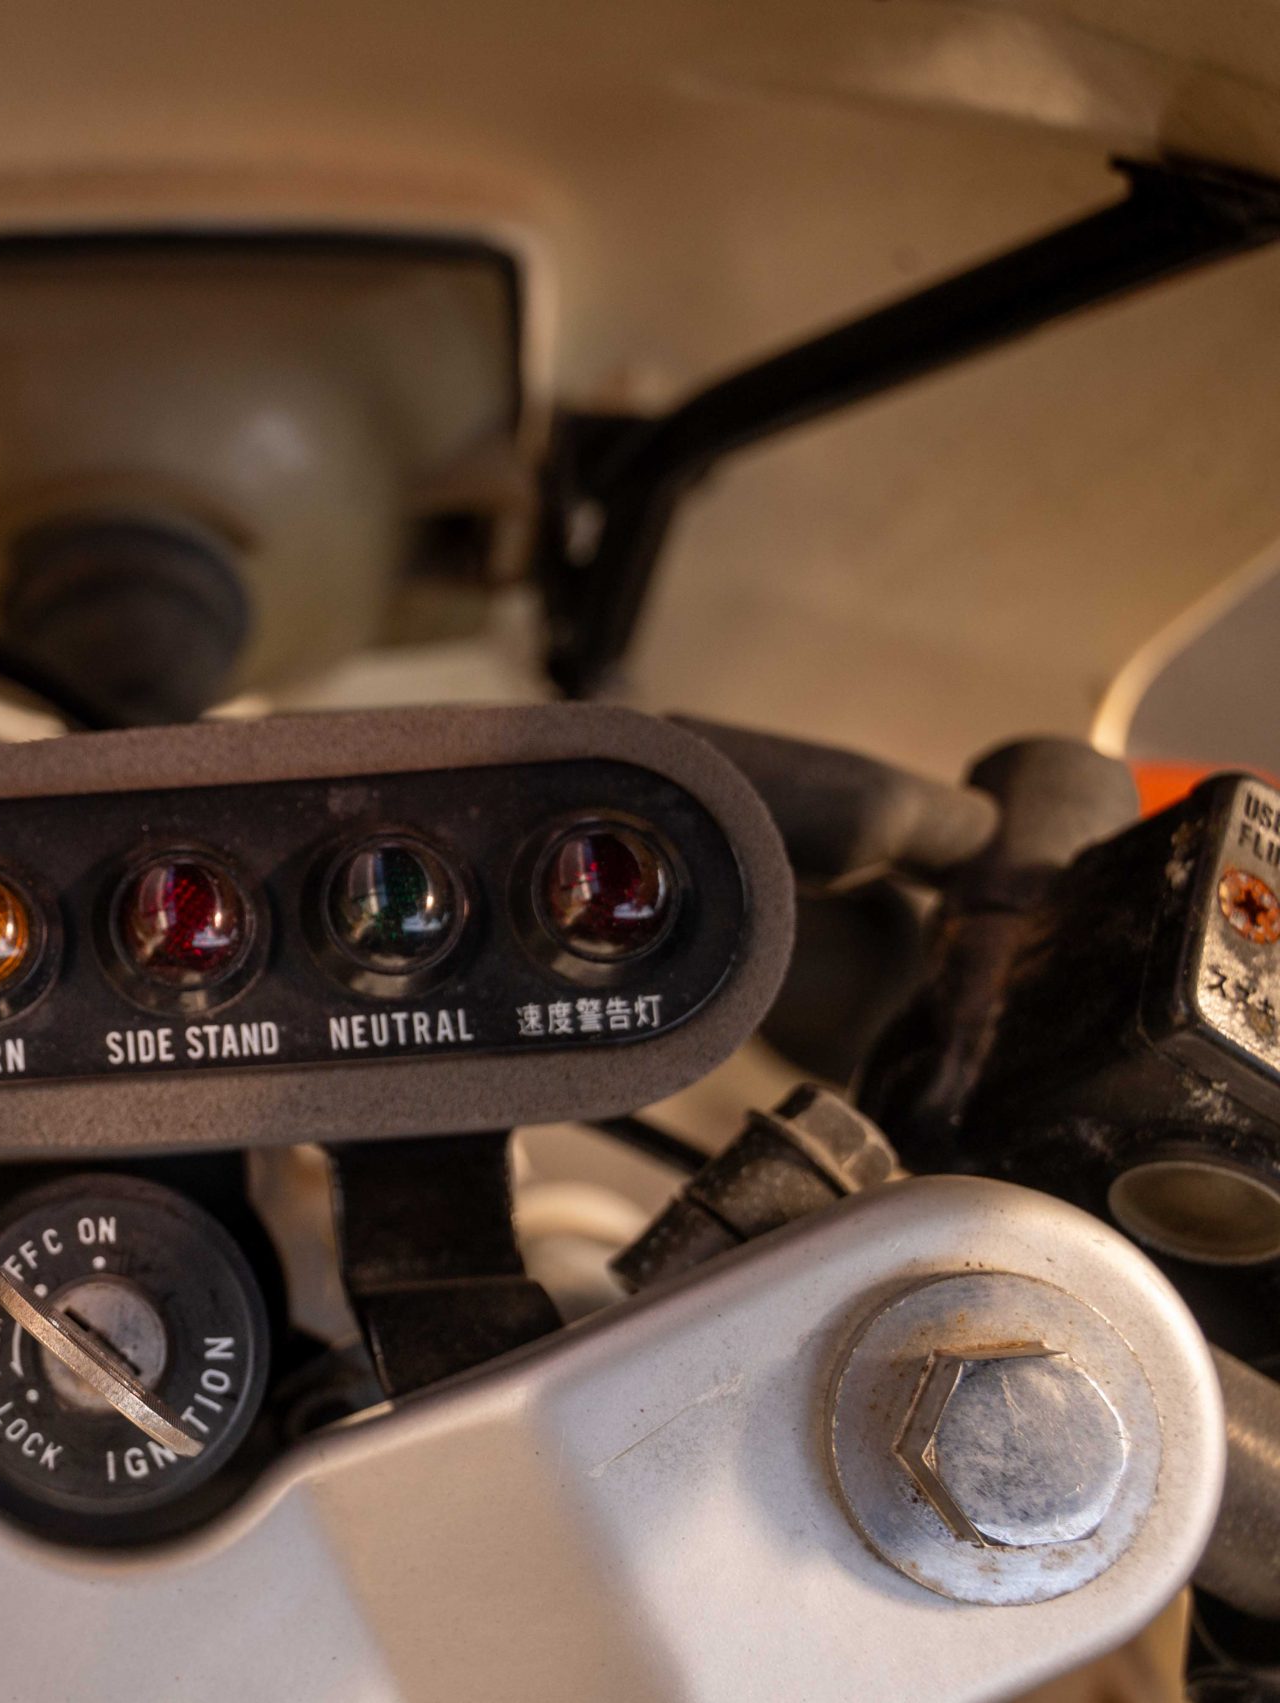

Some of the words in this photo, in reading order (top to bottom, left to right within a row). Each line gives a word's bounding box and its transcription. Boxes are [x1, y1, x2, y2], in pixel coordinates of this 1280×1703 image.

[329, 1007, 475, 1050] NEUTRAL
[516, 993, 663, 1037] 速度警告灯
[105, 1029, 176, 1066] SIDE
[185, 1020, 281, 1058] STAND
[77, 1216, 117, 1245] ON
[105, 1336, 235, 1482] IGNTION
